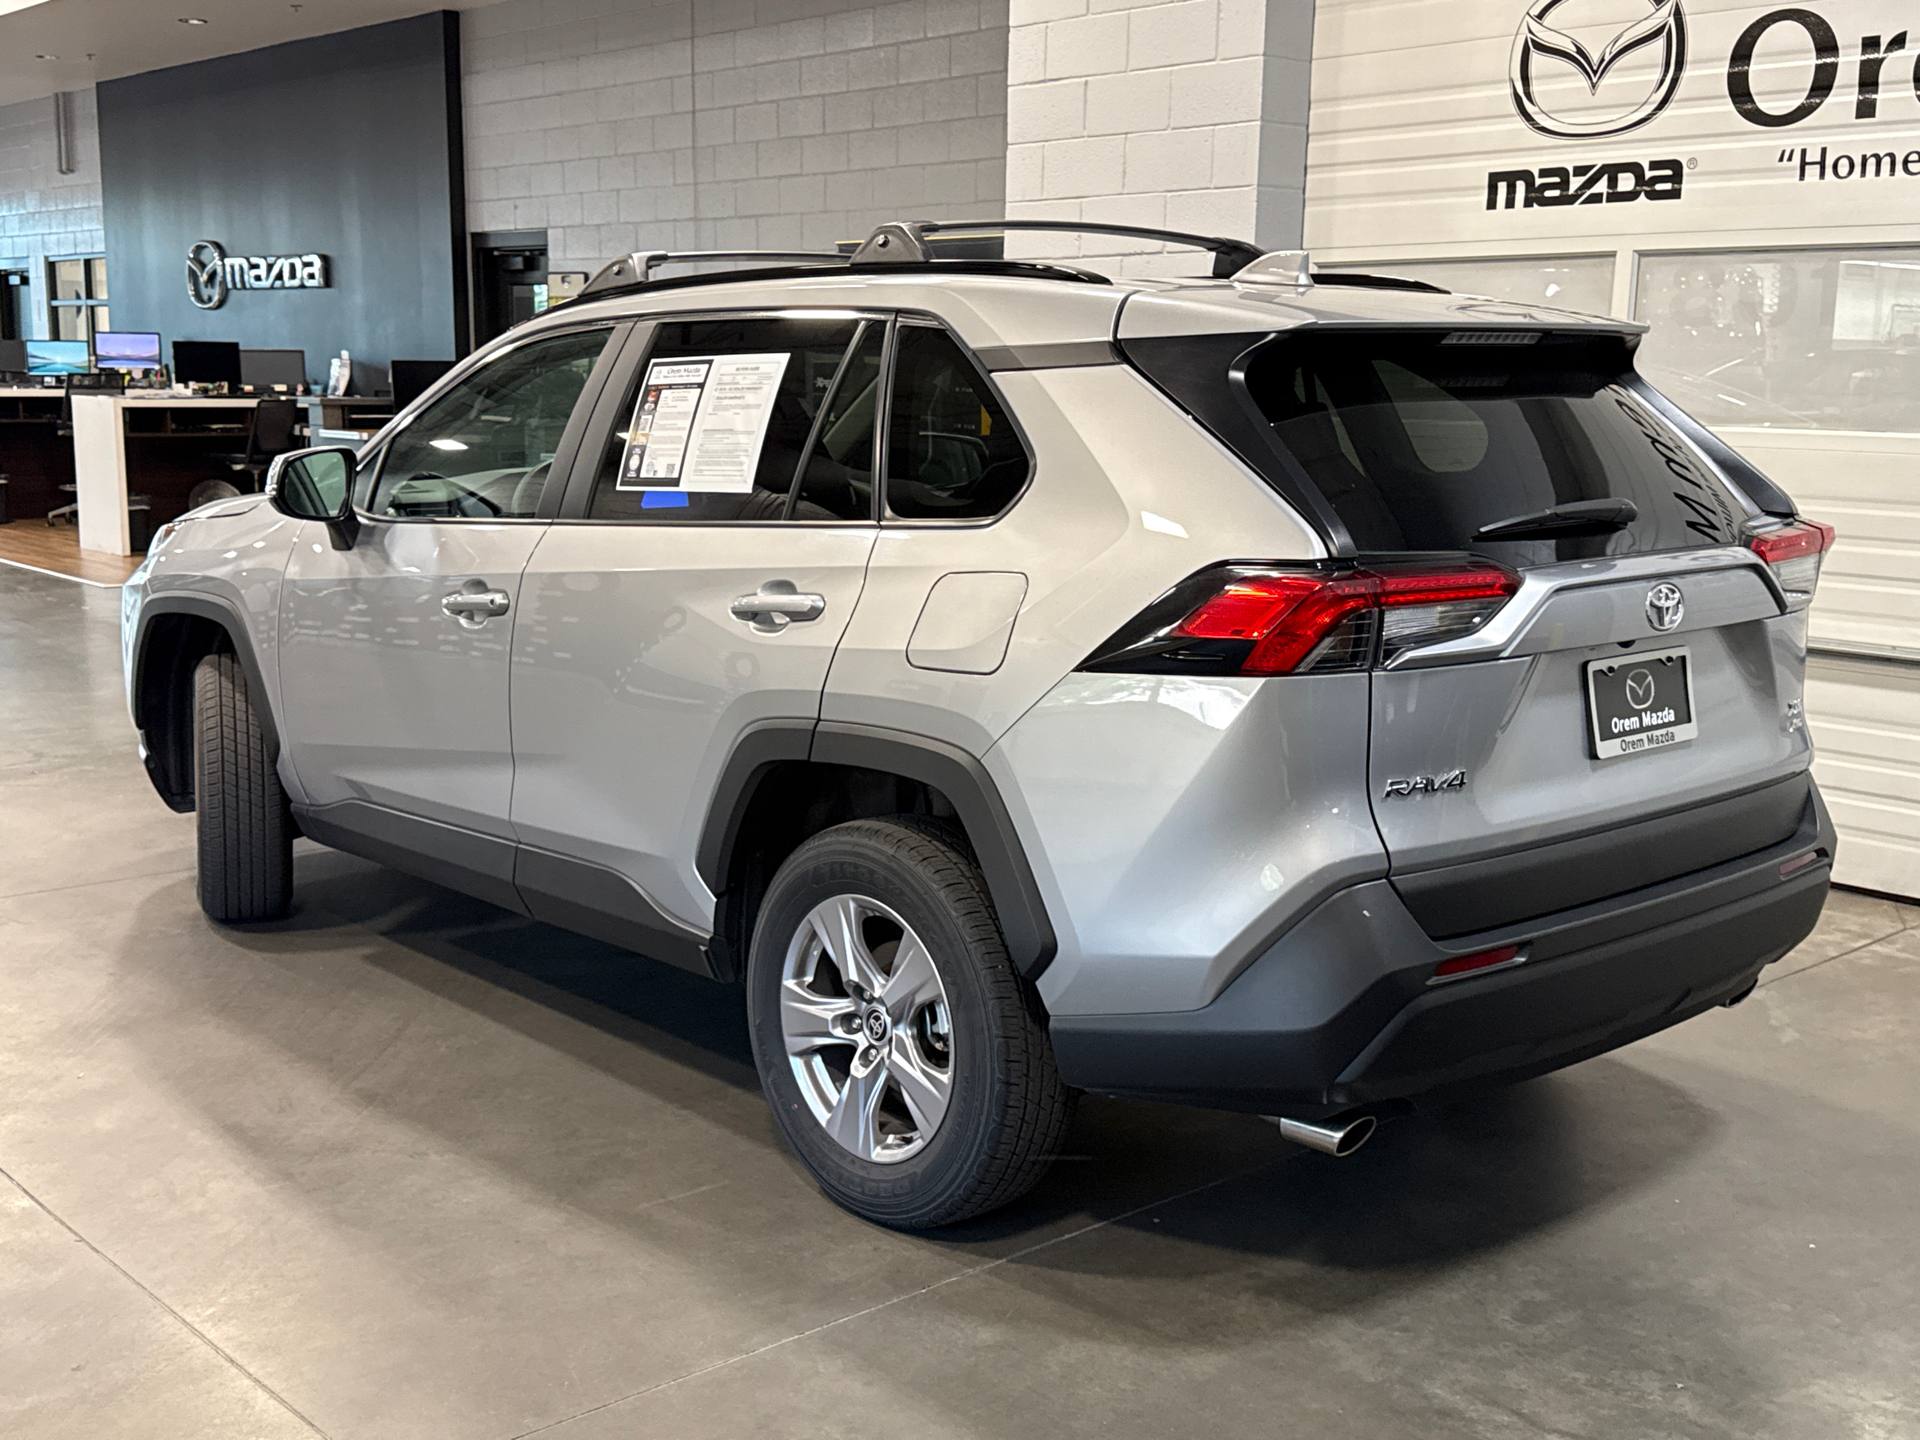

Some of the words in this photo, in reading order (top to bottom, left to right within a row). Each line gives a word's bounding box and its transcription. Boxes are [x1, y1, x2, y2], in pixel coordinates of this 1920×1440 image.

[1727, 8, 1920, 127] Or
[1611, 716, 1640, 734] Orem
[1641, 706, 1676, 728] Mazda
[1620, 738, 1645, 752] Orem
[1646, 730, 1676, 747] Mazda
[1382, 768, 1468, 799] RAV4
